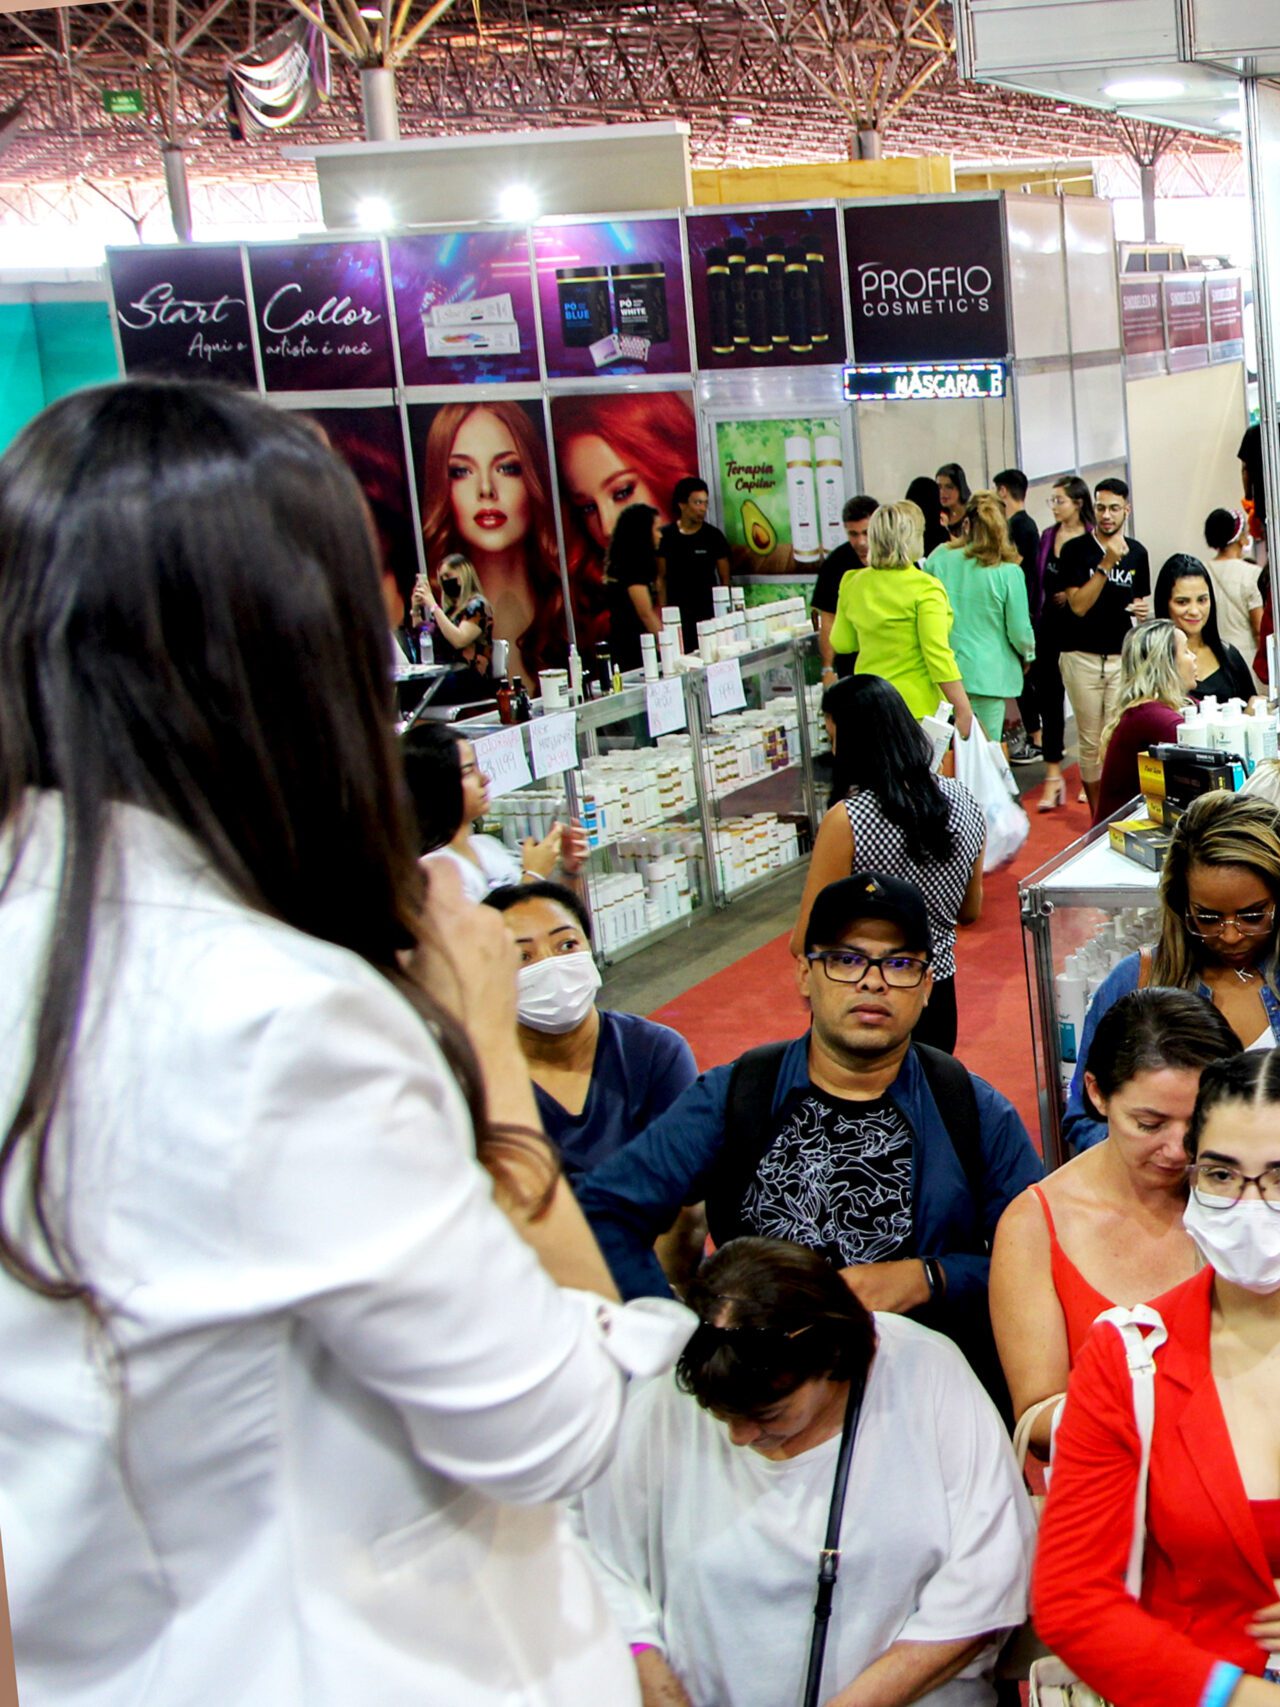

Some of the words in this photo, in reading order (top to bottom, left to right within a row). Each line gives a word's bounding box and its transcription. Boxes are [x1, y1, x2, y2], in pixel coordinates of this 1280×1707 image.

[859, 264, 992, 300] PROFFIO
[118, 283, 246, 330] Start
[263, 283, 381, 333] Collor
[565, 309, 590, 320] BLUE
[620, 307, 647, 316] WHITE
[862, 297, 990, 317] COSMETIC'S
[188, 332, 232, 362] Aqui
[236, 342, 248, 350] o
[265, 335, 319, 357] artista
[321, 340, 333, 354] é
[337, 340, 372, 355] você
[895, 369, 979, 395] MÁSCARA
[725, 460, 774, 480] Terapia
[735, 477, 776, 493] Capilar
